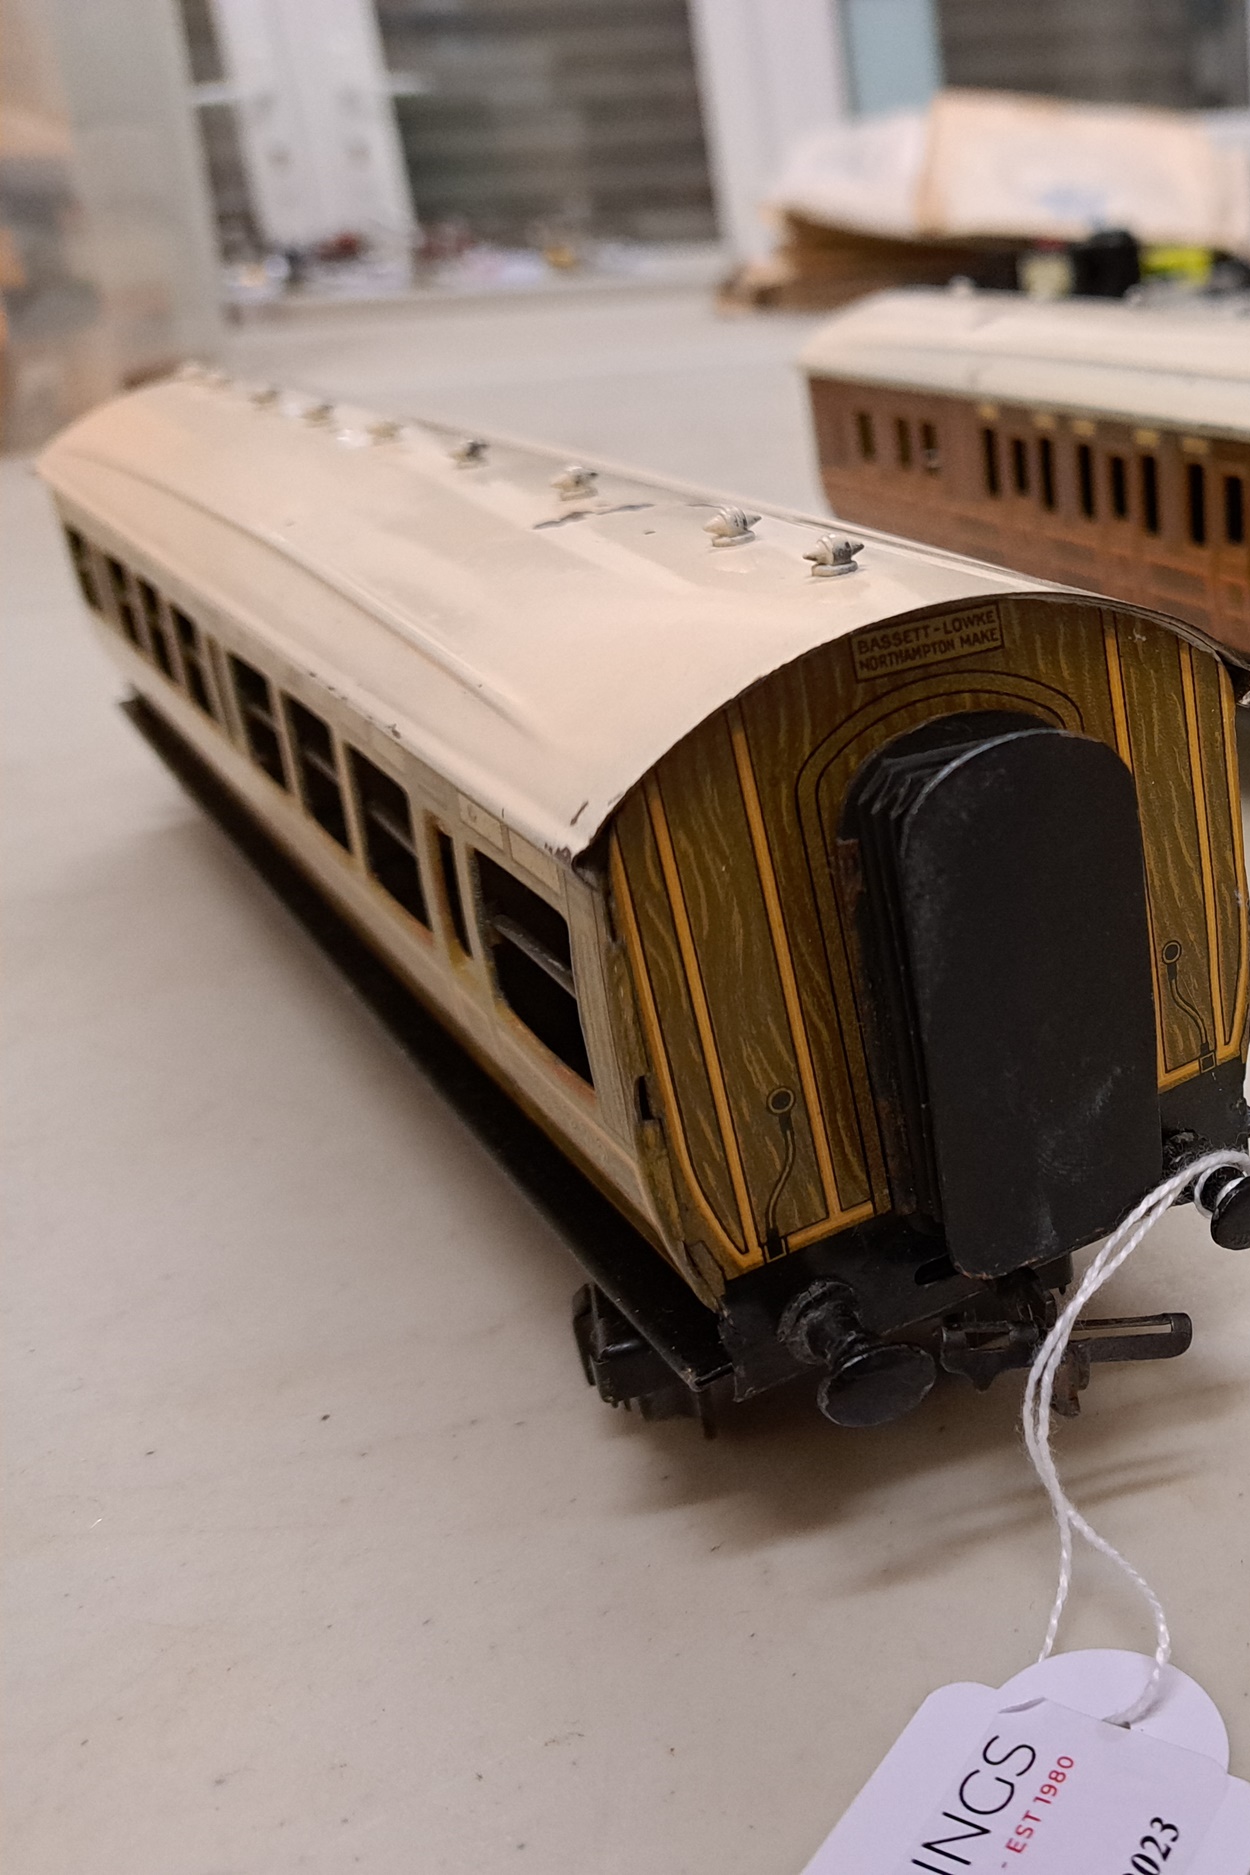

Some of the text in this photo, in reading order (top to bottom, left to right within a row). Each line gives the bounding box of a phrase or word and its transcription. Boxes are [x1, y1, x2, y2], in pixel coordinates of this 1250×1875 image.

[858, 627, 999, 672] NORTHAMPTON MAKE
[1005, 1810, 1042, 1854] EST
[1033, 1756, 1074, 1805] 1980
[1122, 1817, 1179, 1875] 023
